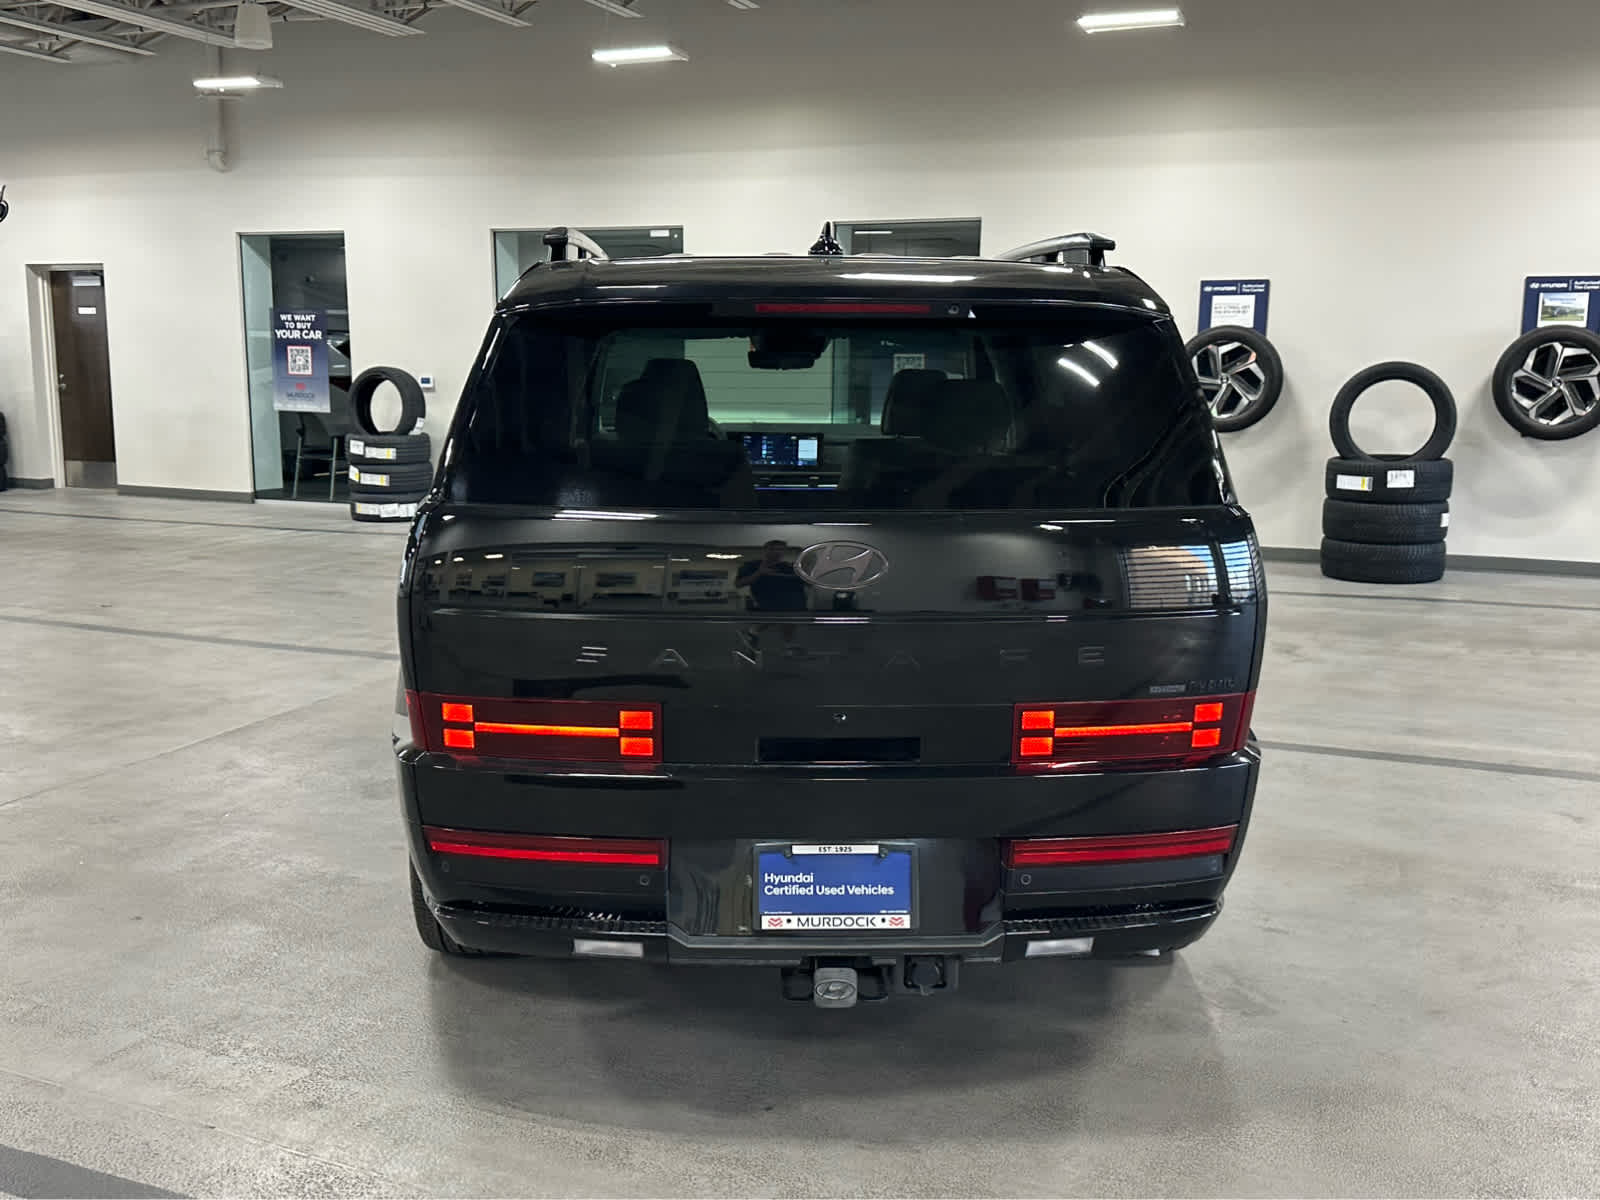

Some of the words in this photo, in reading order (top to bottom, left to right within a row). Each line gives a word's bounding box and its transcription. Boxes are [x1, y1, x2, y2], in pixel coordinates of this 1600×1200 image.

[275, 329, 301, 339] YOUR
[302, 330, 322, 339] CAR
[575, 645, 921, 671] SANTA
[1000, 645, 1105, 667] FE
[764, 872, 814, 885] Hyundai
[764, 885, 814, 896] Certified
[816, 885, 845, 896] Used
[847, 885, 895, 896] Vehicles
[797, 916, 877, 927] MURDOCK
